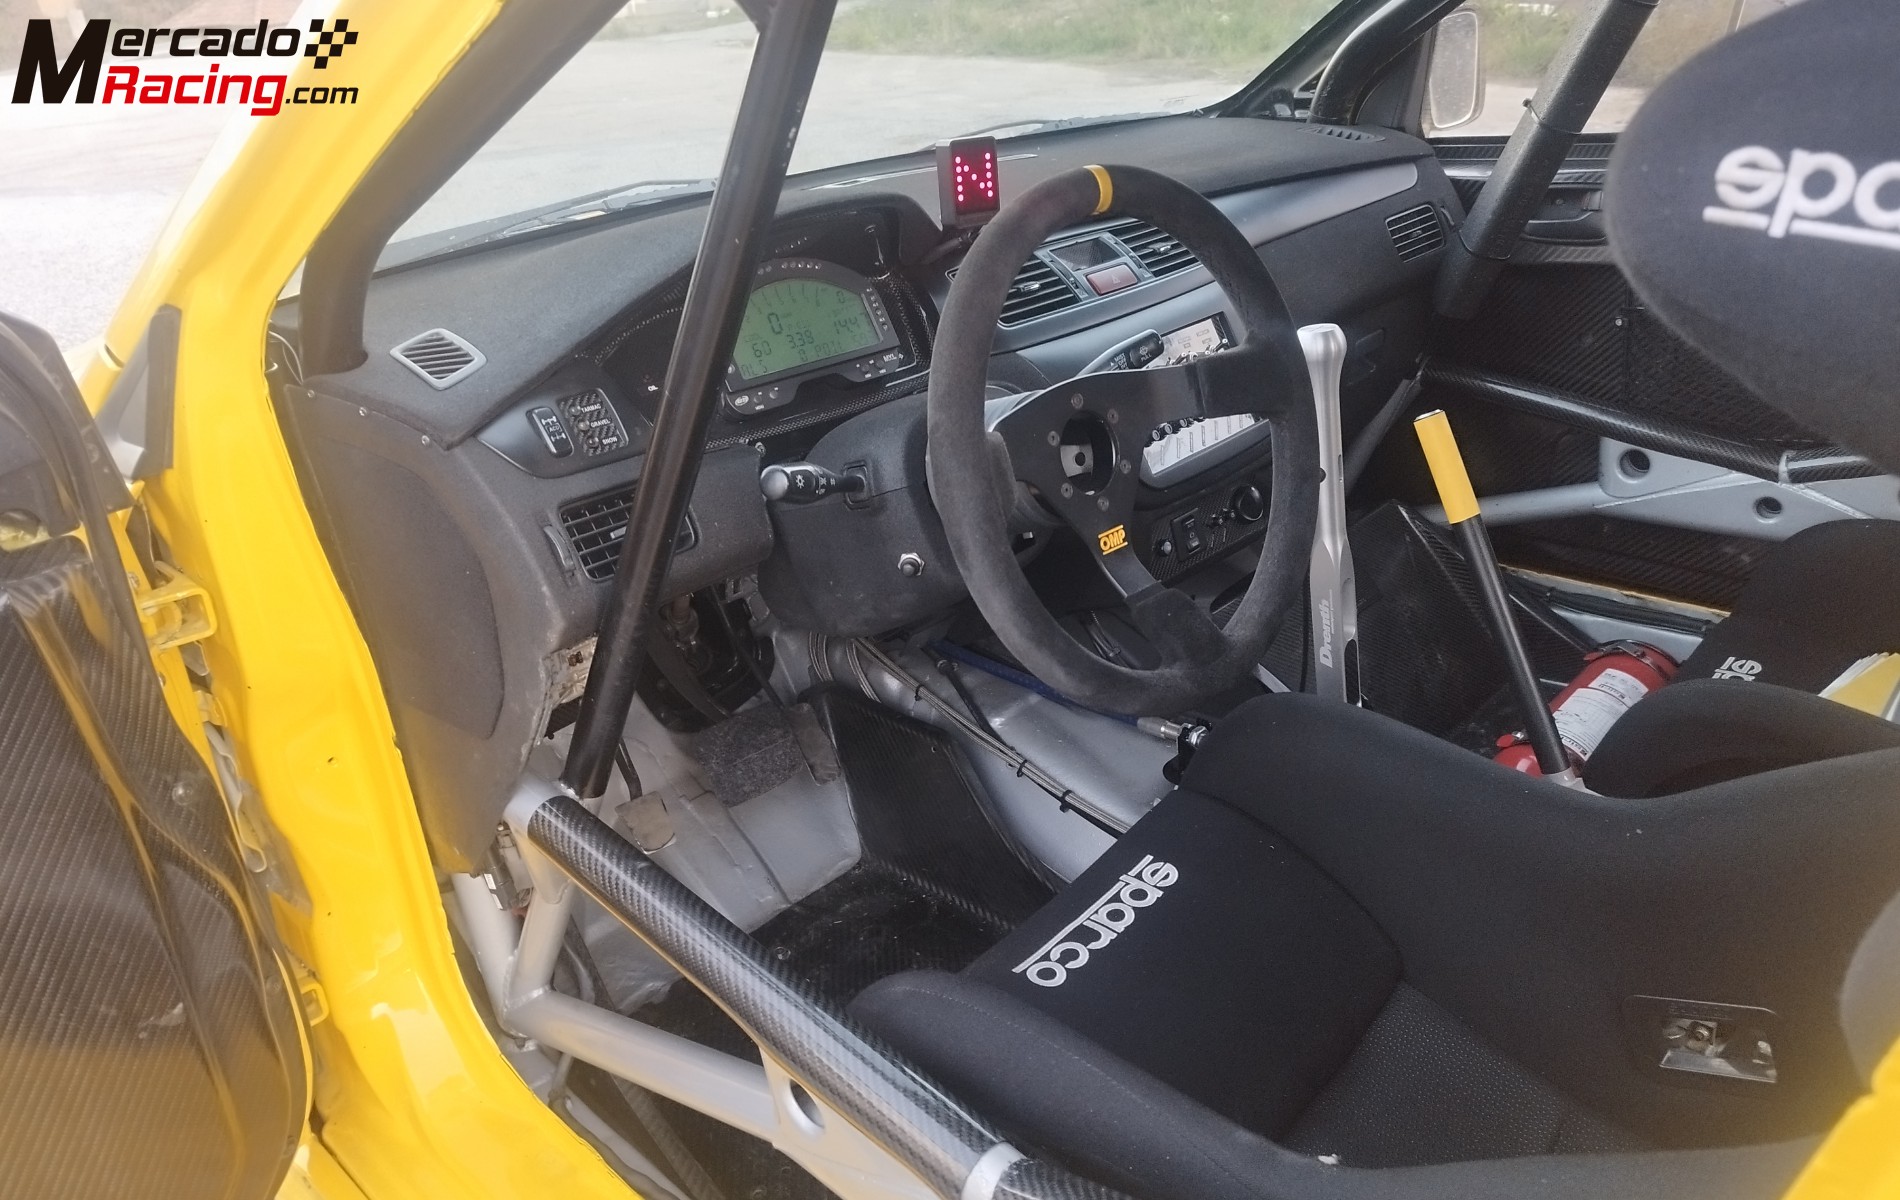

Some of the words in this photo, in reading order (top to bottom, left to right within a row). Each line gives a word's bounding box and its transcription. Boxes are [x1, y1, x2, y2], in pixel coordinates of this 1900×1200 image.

[955, 152, 993, 202] N
[752, 340, 773, 358] 60
[581, 403, 601, 413] TARMAC
[590, 418, 610, 428] GRAVEL
[602, 436, 618, 445] SNOW
[1099, 527, 1127, 553] OMP
[1319, 598, 1333, 669] Drenth
[1011, 854, 1179, 988] sparco
